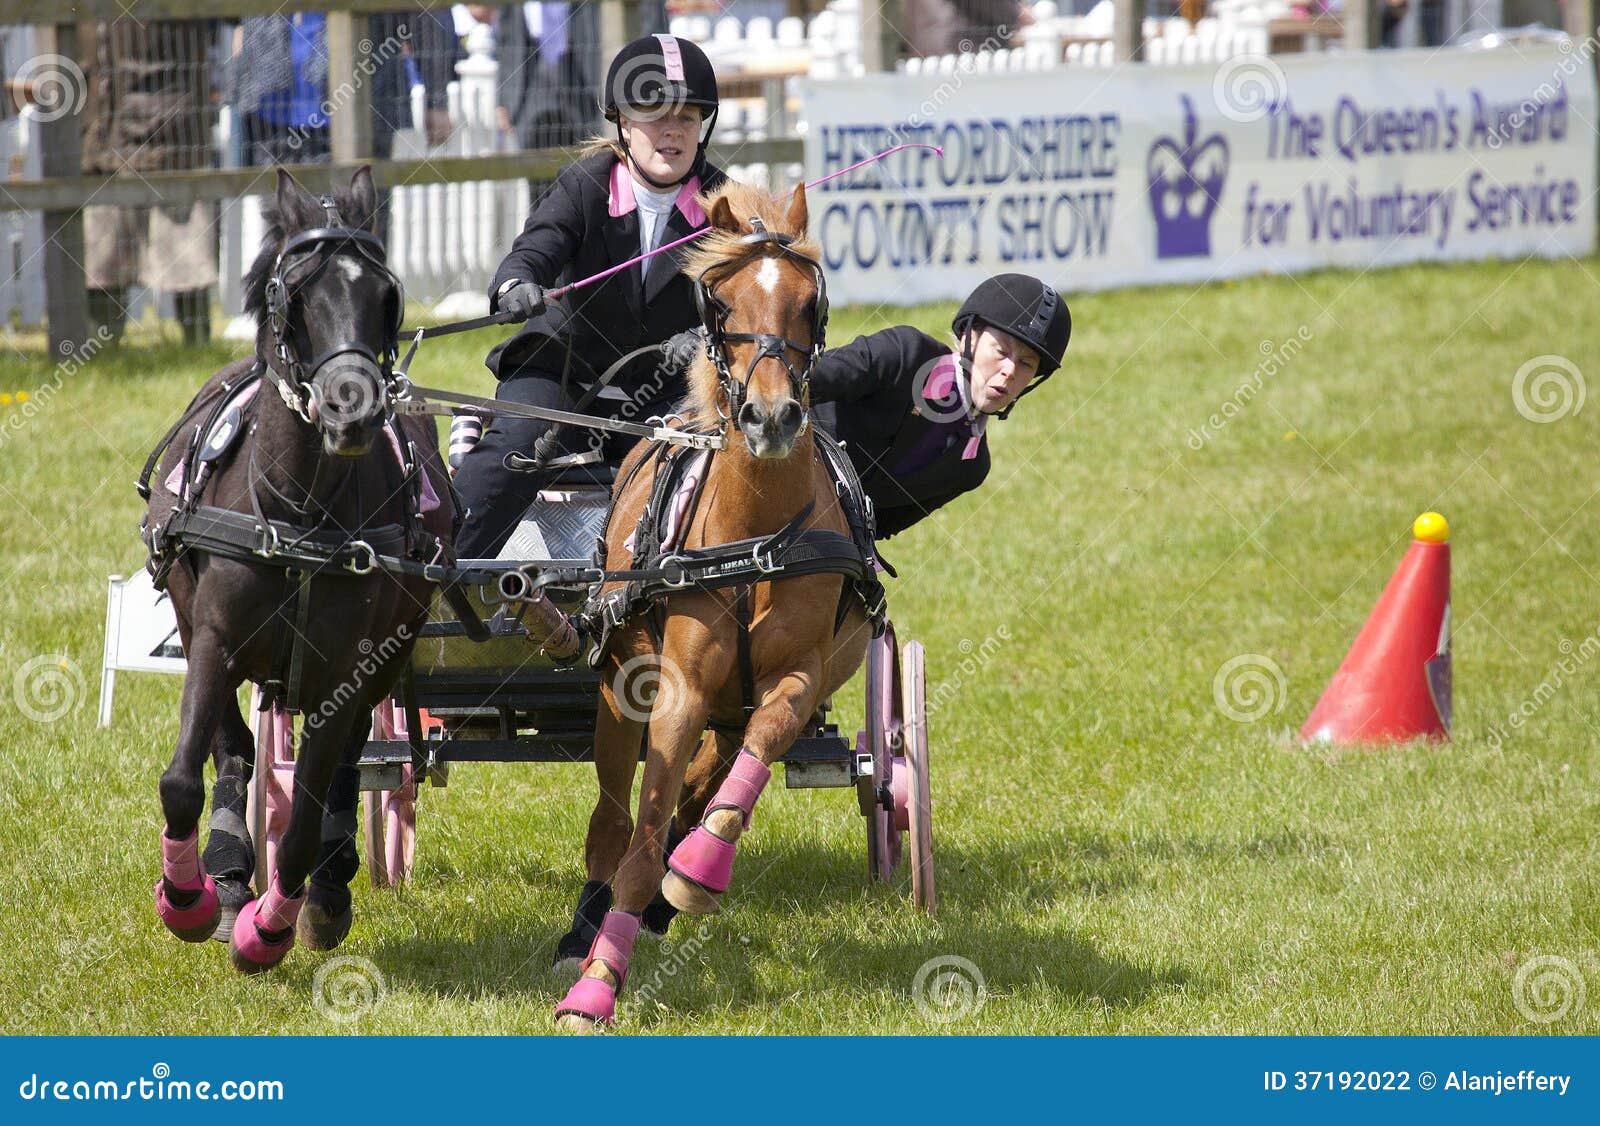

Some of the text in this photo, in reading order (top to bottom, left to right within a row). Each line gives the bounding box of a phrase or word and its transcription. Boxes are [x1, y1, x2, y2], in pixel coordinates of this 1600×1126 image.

[820, 112, 1121, 193] HERTFORDSHIRE
[1263, 80, 1570, 162] The Queen's Award
[819, 190, 1117, 272] COUNTY SHOW
[1241, 164, 1581, 250] for Voluntary Service
